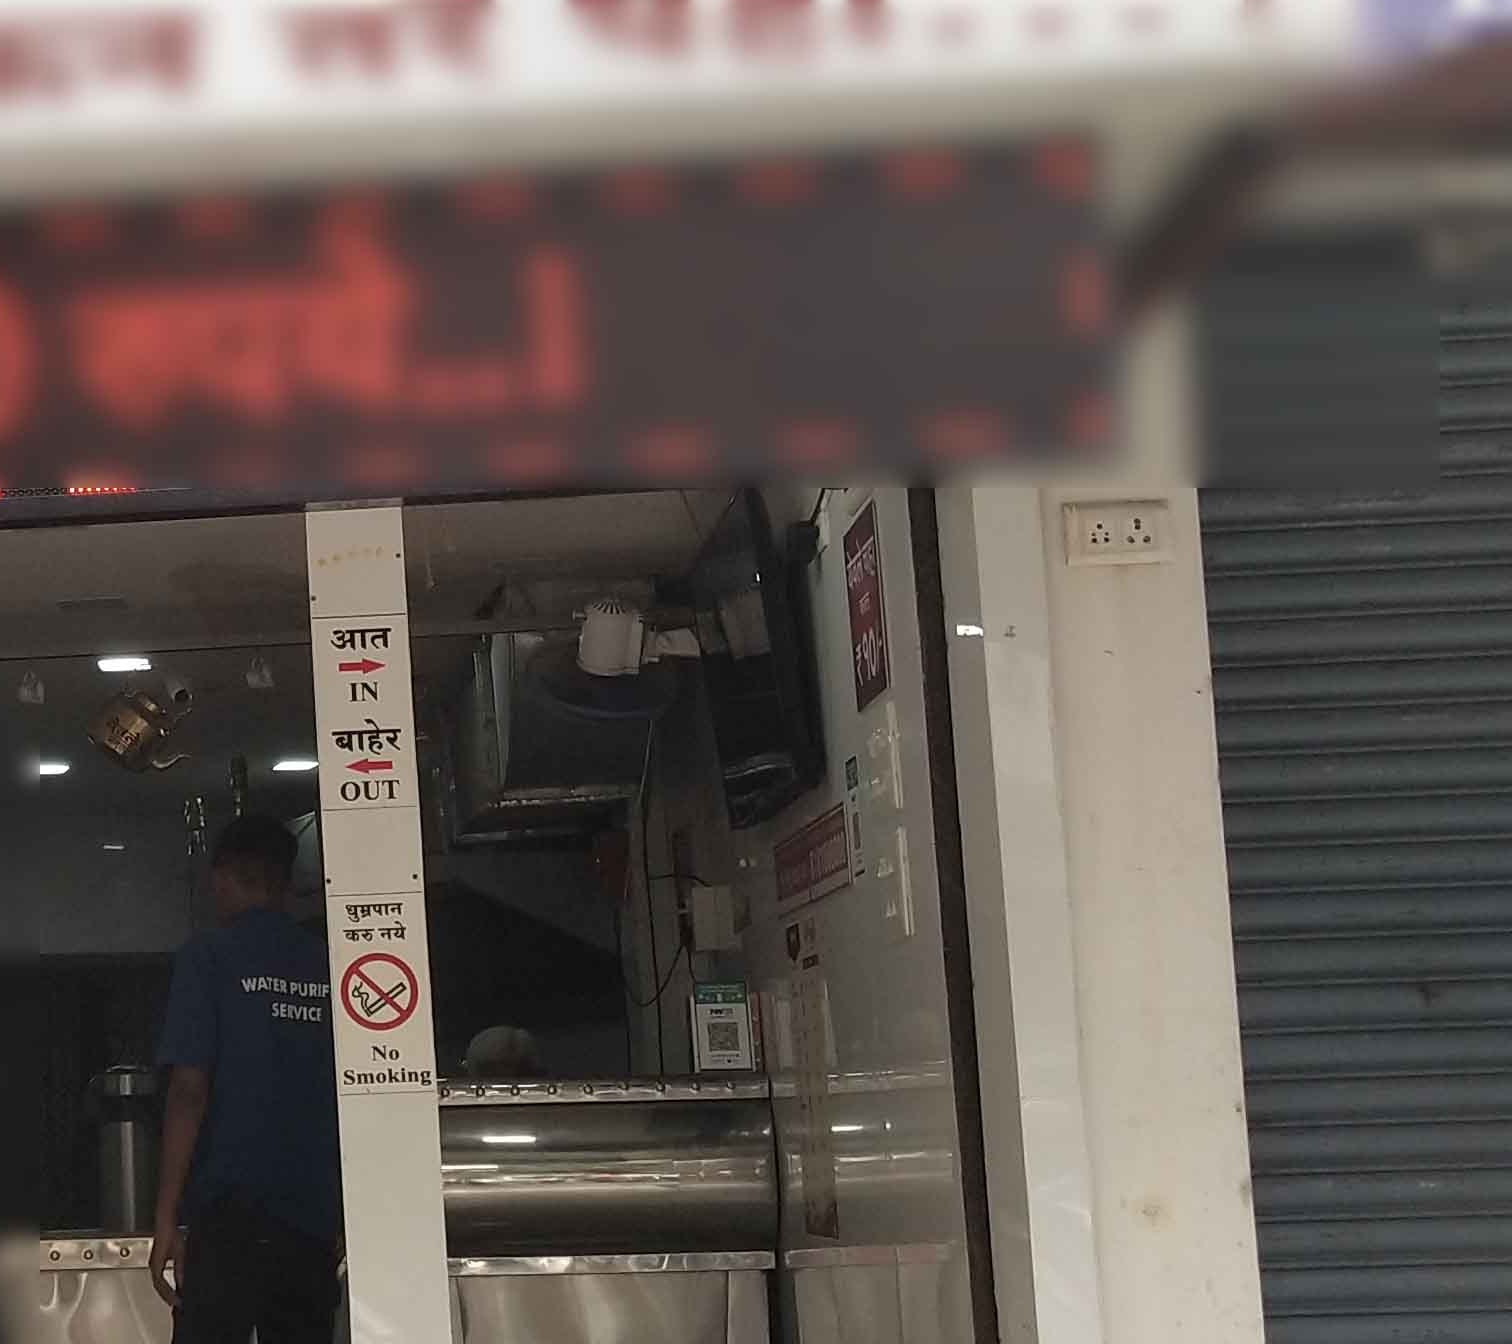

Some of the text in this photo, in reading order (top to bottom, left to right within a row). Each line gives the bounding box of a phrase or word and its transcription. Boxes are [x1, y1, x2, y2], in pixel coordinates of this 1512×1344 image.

[330, 627, 392, 651] आत
[349, 681, 379, 703] IN
[331, 718, 402, 756] बाहेर
[340, 779, 400, 802] OUT
[380, 920, 406, 942] नये
[241, 975, 330, 999] WATER PURIF
[271, 1002, 323, 1022] SERVICE
[371, 1045, 400, 1061] No
[343, 1066, 432, 1087] Smoking
